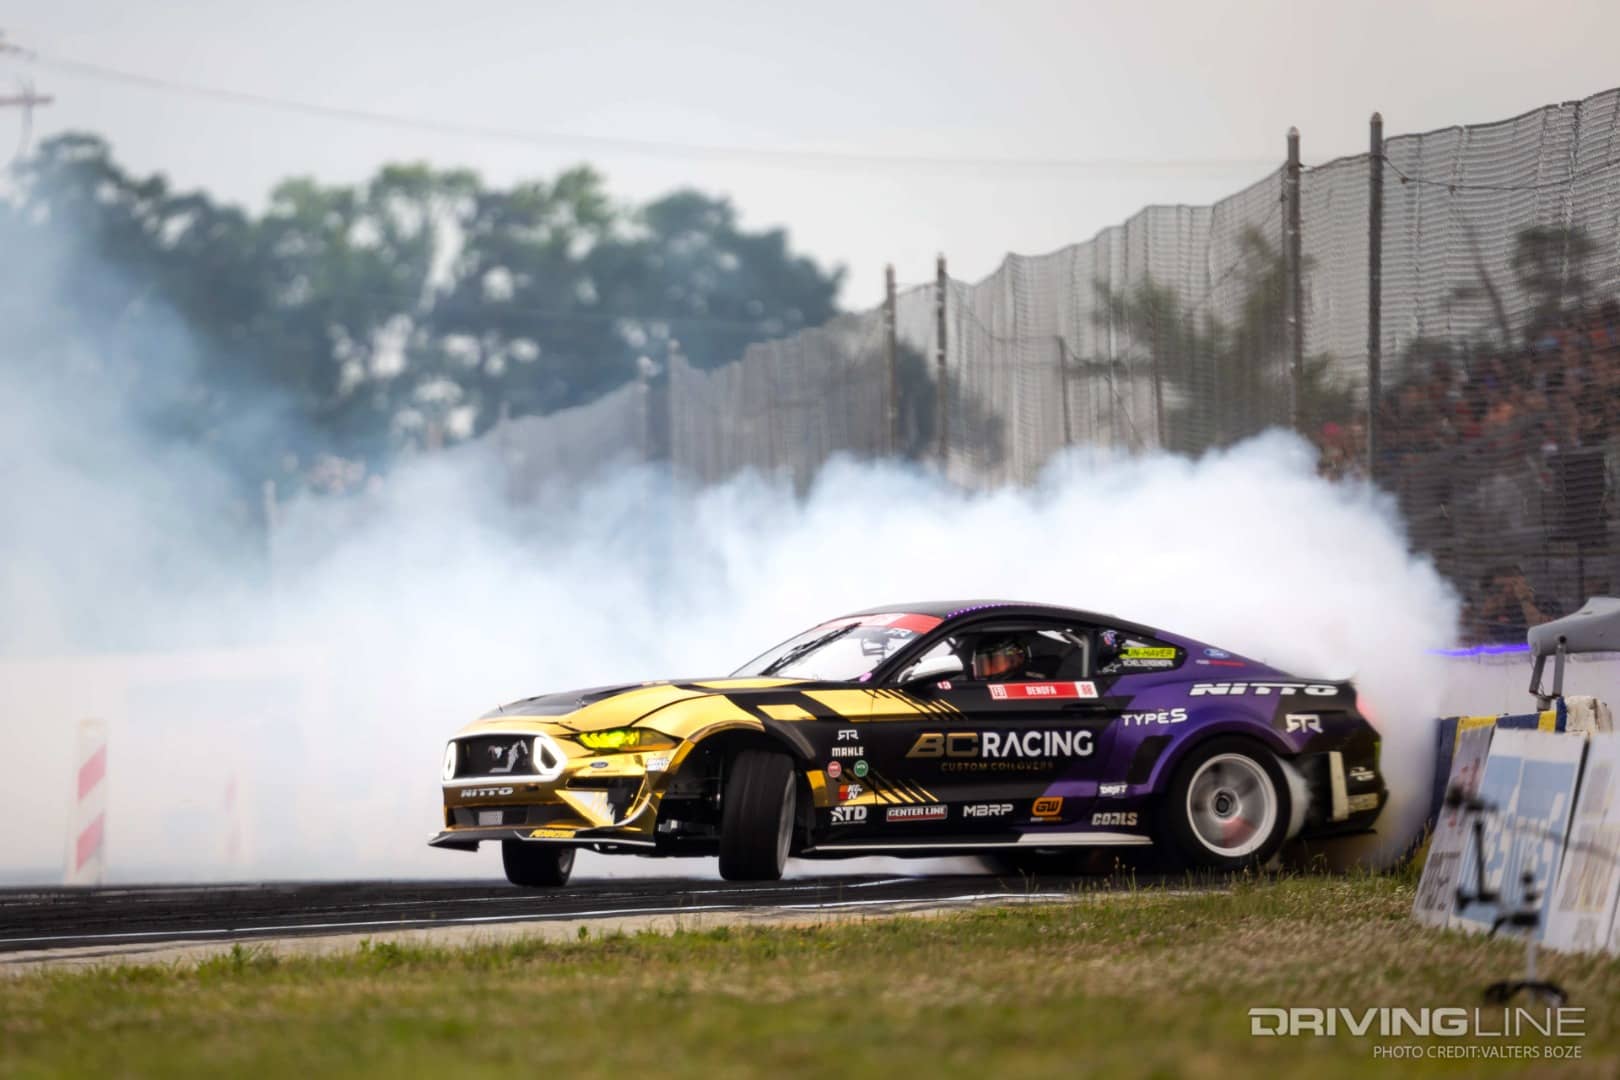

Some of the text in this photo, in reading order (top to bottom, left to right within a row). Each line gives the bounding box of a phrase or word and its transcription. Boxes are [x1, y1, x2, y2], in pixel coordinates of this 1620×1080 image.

[1190, 683, 1338, 696] NITTO
[981, 731, 1094, 758] RACING
[831, 746, 865, 758] MAHLE
[941, 762, 987, 771] CUSTOM
[461, 787, 514, 798] NITTO
[888, 807, 944, 817] CENTER LINE
[963, 804, 1013, 818] MBRP
